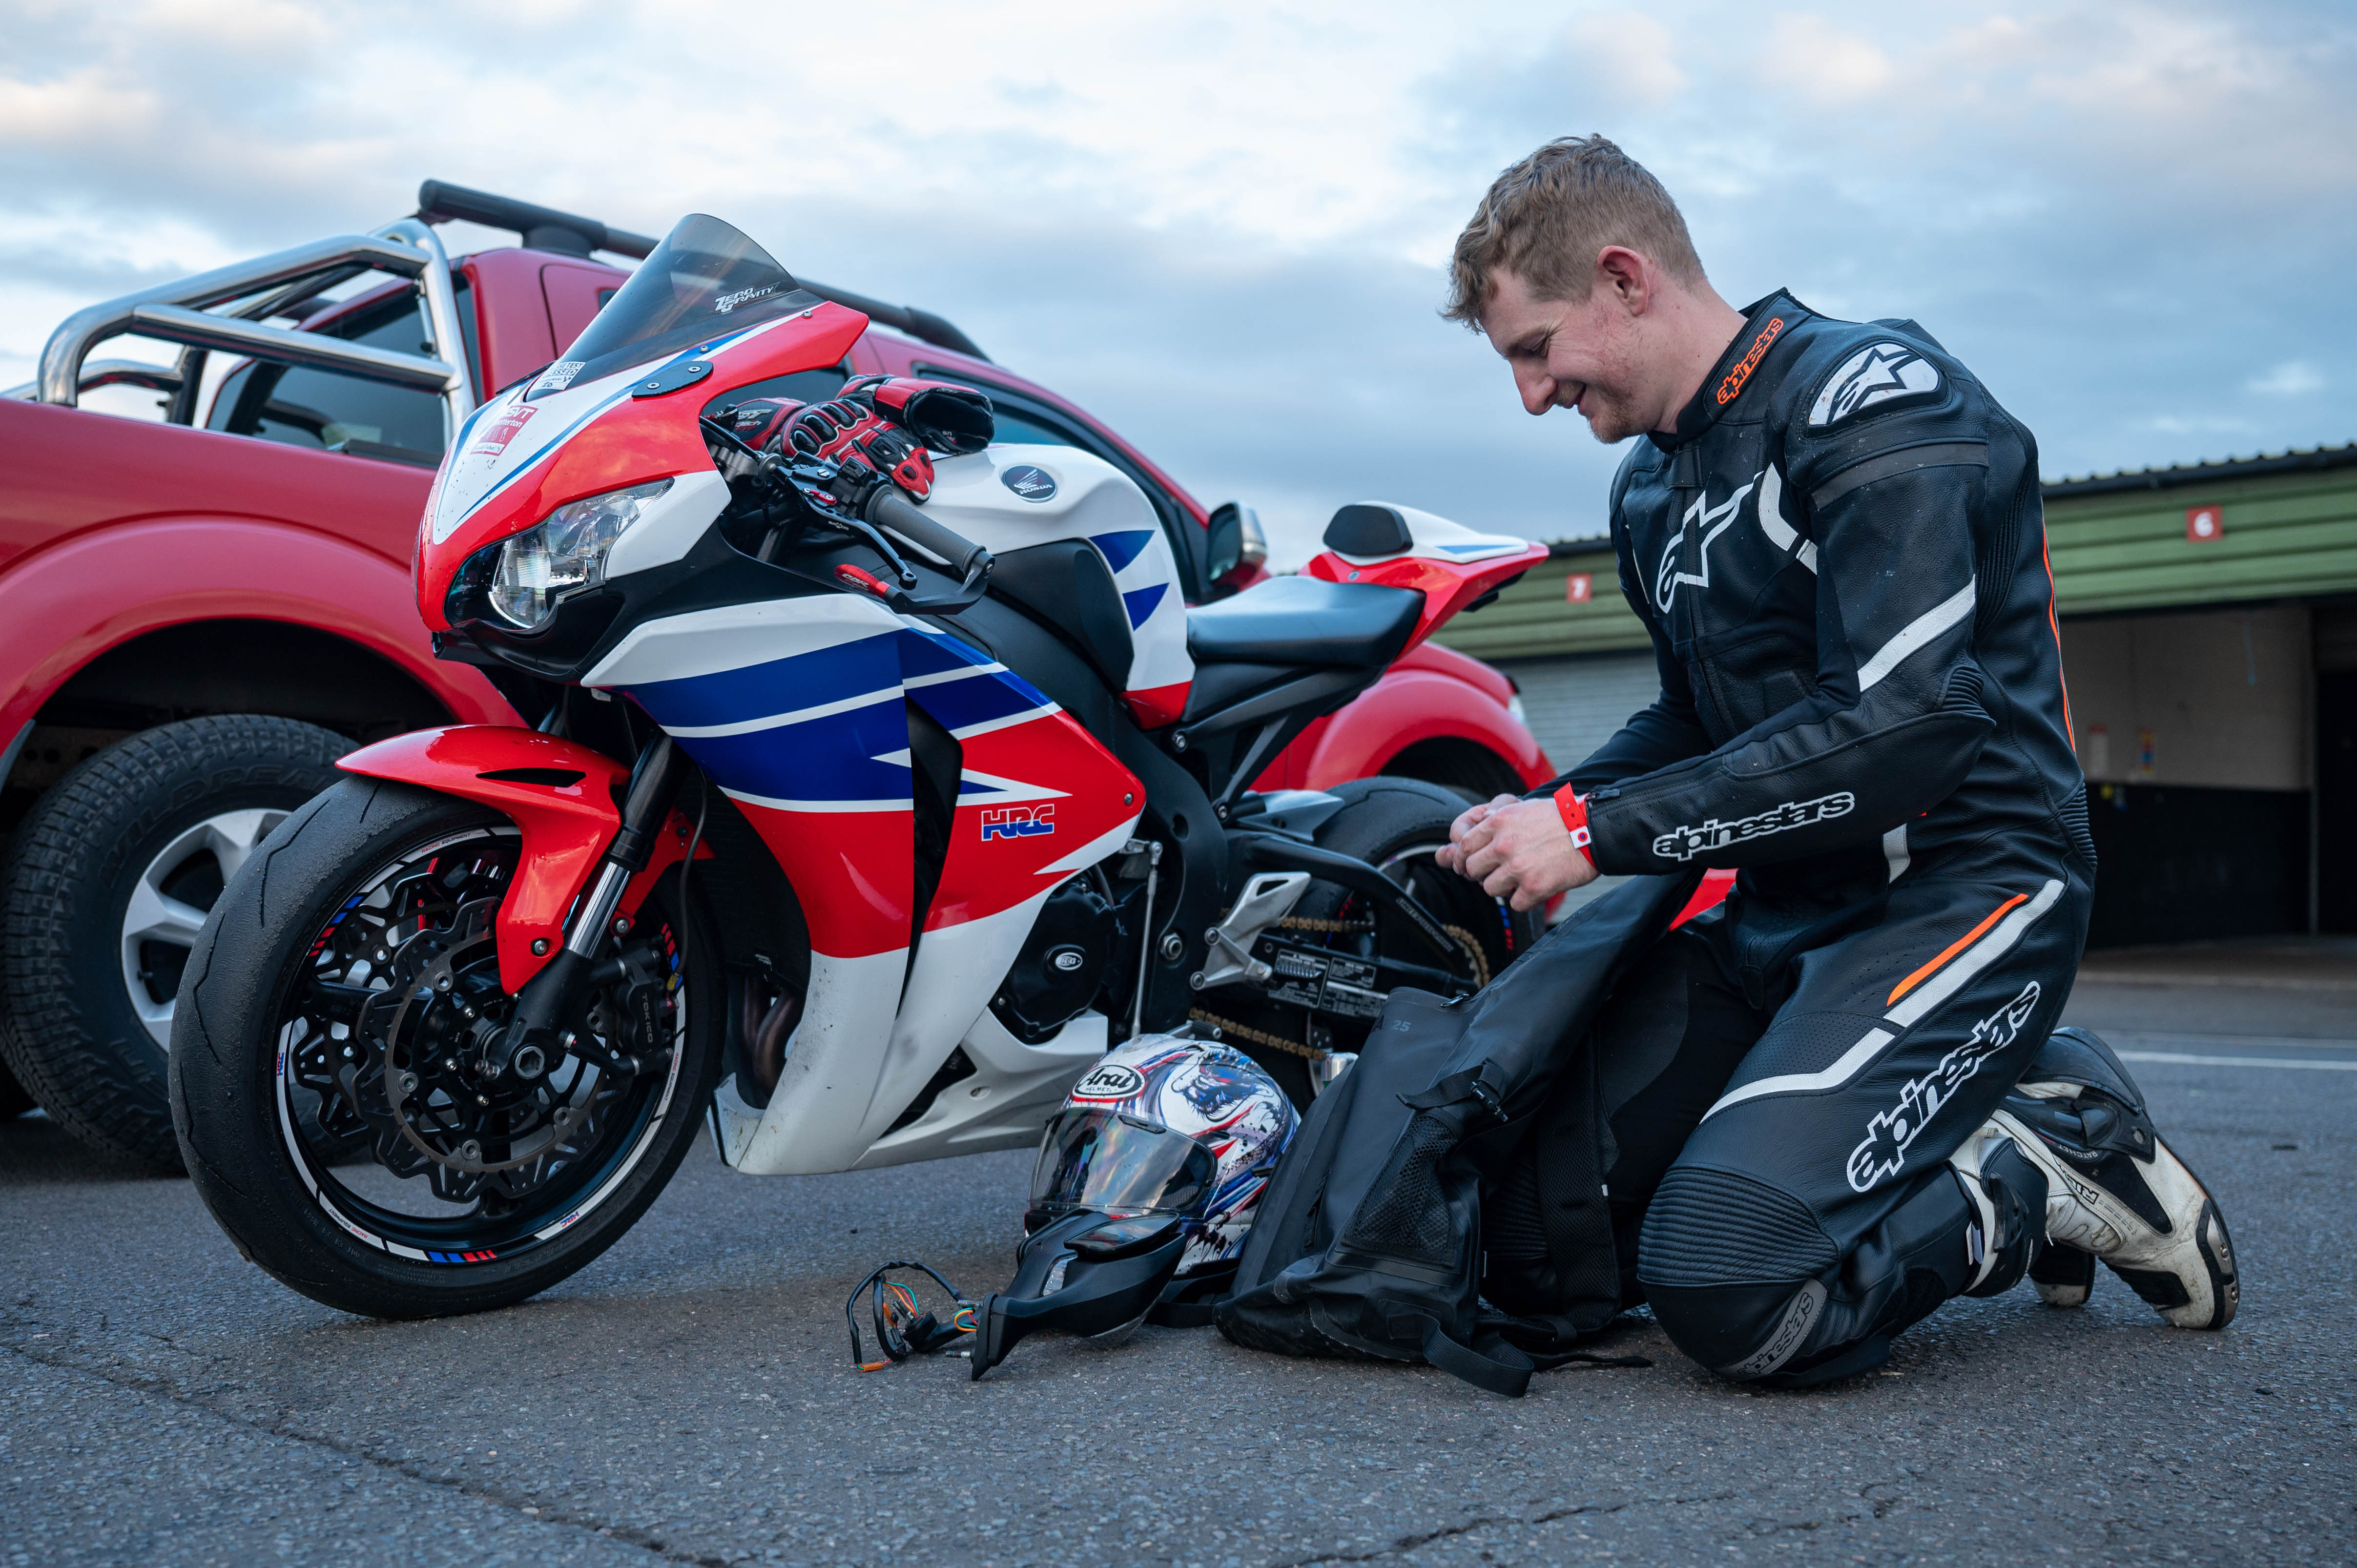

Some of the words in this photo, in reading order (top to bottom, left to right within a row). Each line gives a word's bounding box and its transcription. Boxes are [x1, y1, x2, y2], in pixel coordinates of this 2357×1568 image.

[715, 288, 754, 311] ZERO
[721, 286, 774, 313] GRAVITY
[1716, 317, 1784, 405] alpinestars
[1018, 484, 1054, 495] HONDA
[2193, 512, 2213, 537] 6
[981, 804, 1055, 842] HRC
[1653, 791, 1855, 862] alpinestars
[421, 842, 440, 854] RACING
[441, 832, 471, 845] EQUIPMENT
[642, 992, 653, 1043] TOKICO
[1390, 1019, 1412, 1032] 25
[277, 1052, 285, 1076] HRC
[664, 1072, 675, 1101] EQUIPMENT
[1077, 1067, 1136, 1089] Arai
[1846, 980, 2041, 1193] alpinestars
[2058, 1144, 2099, 1159] RATCHET
[328, 1208, 351, 1228] EQUIPMENT
[559, 1210, 580, 1228] HRC
[351, 1226, 369, 1239] RACING
[1736, 1292, 1814, 1376] alpinestars
